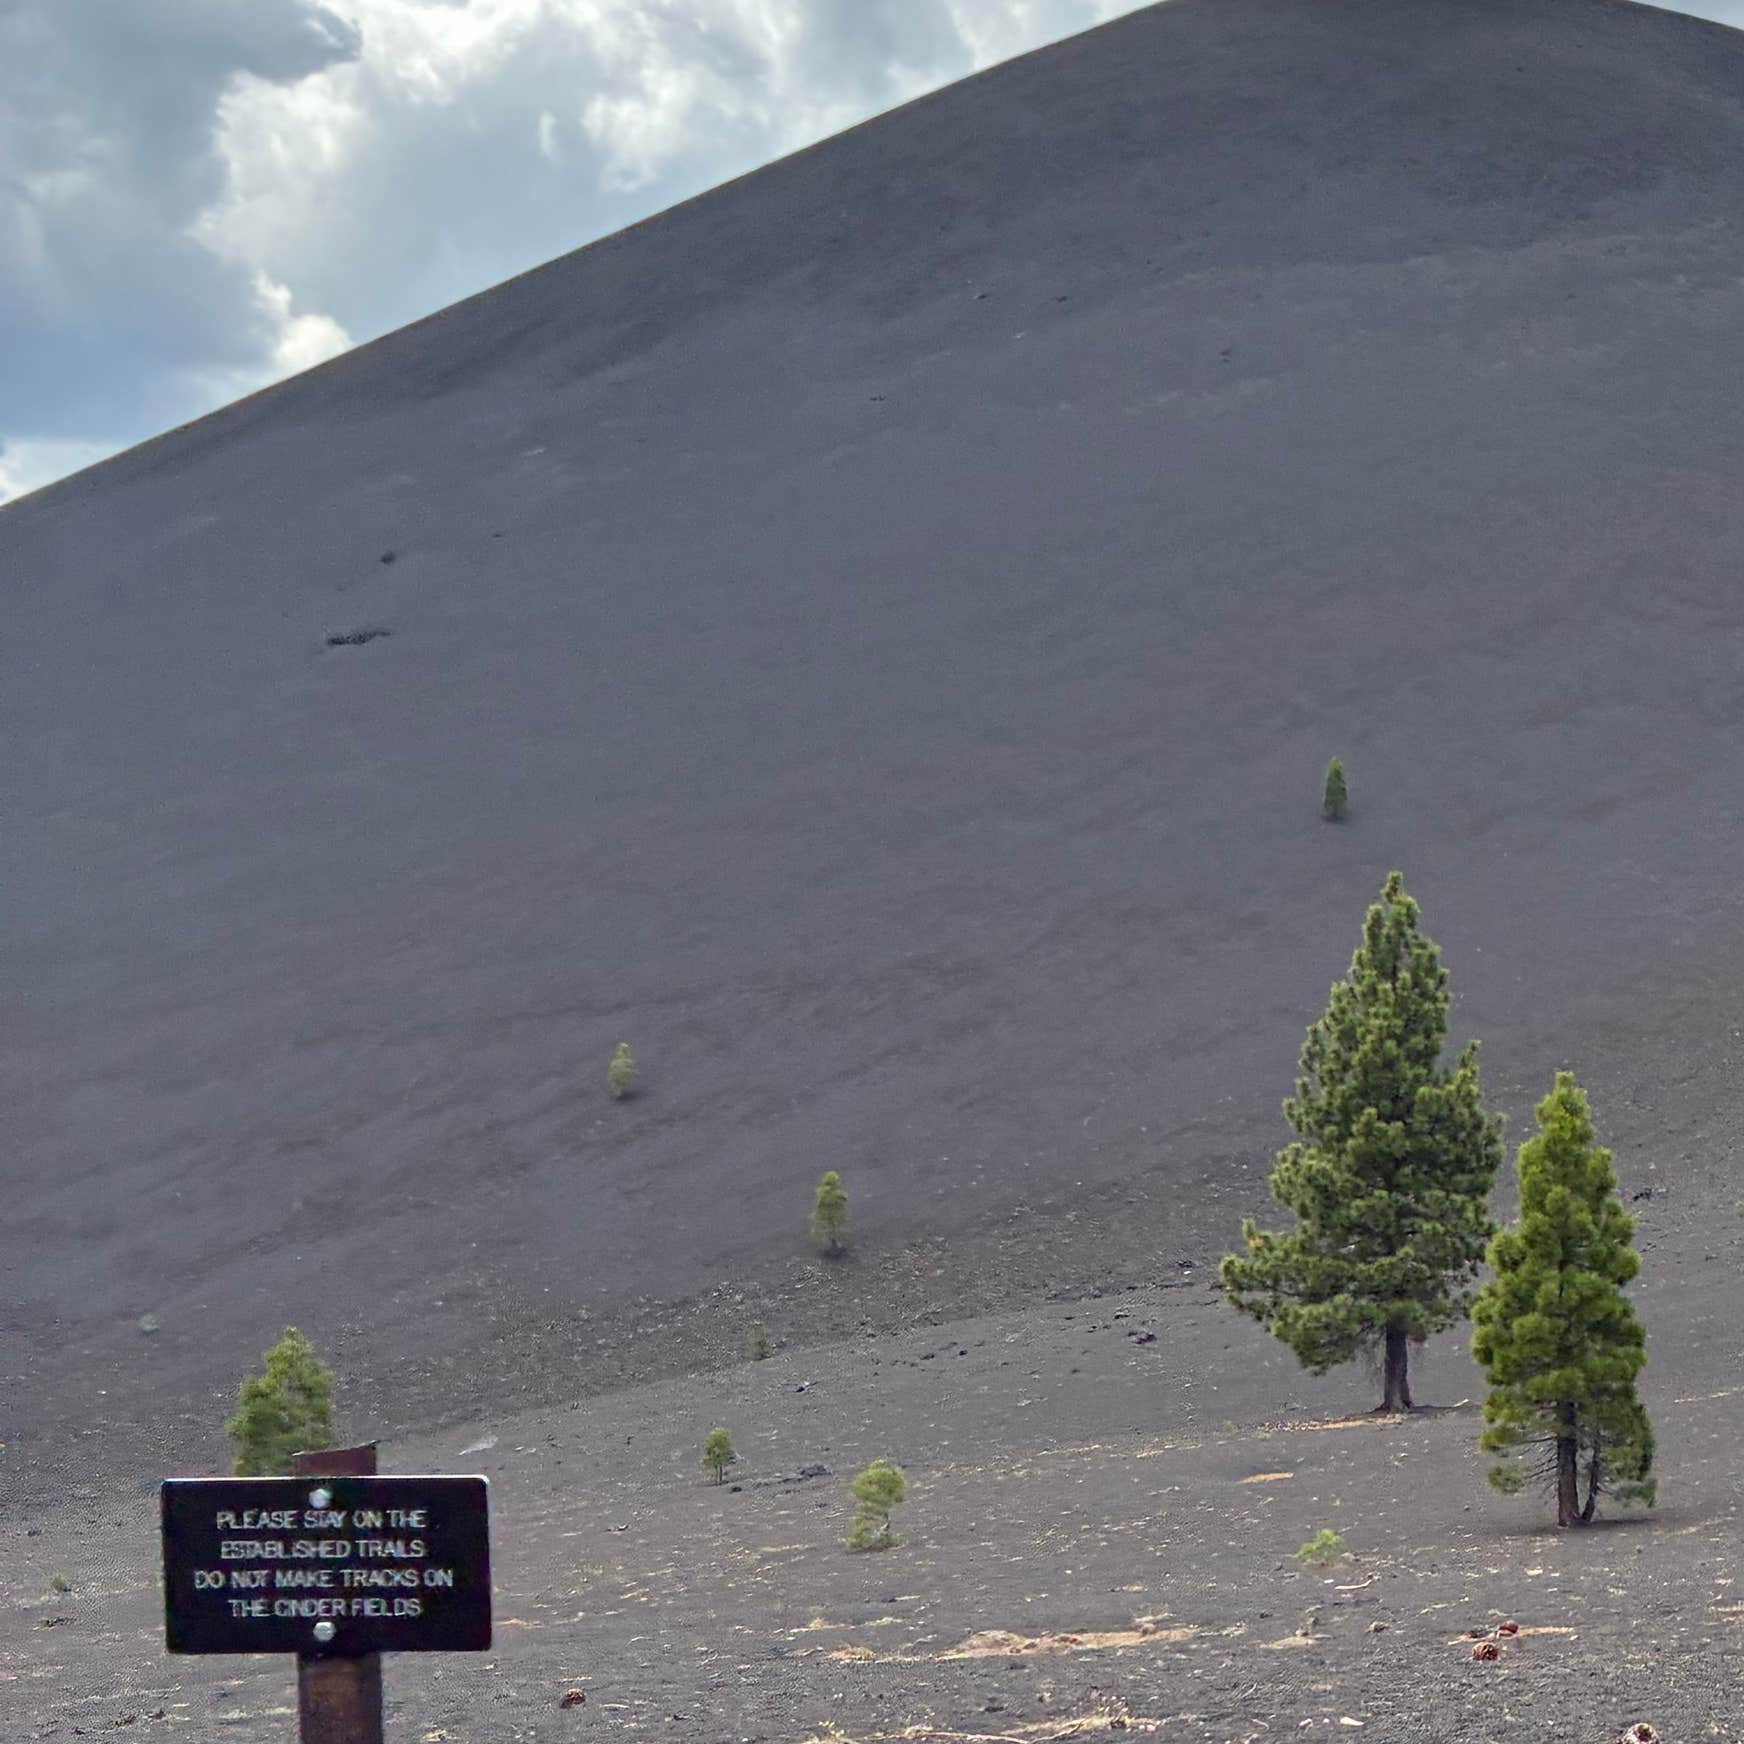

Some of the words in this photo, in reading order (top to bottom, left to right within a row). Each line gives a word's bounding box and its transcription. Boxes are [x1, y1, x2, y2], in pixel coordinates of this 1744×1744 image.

[217, 1510, 295, 1529] PLEASE
[304, 1510, 346, 1528] STAY
[353, 1510, 382, 1528] ON
[387, 1510, 428, 1528] THE
[221, 1541, 350, 1559] ESTABLISHED
[356, 1540, 425, 1557] TRAILS
[195, 1571, 225, 1589] DO
[232, 1570, 268, 1587] NOT
[276, 1570, 334, 1587] MAKE
[340, 1570, 419, 1587] TRACKS
[424, 1569, 452, 1586] ON
[228, 1599, 270, 1617] THE
[275, 1599, 345, 1617] CINDER
[352, 1599, 422, 1617] FIELDS
